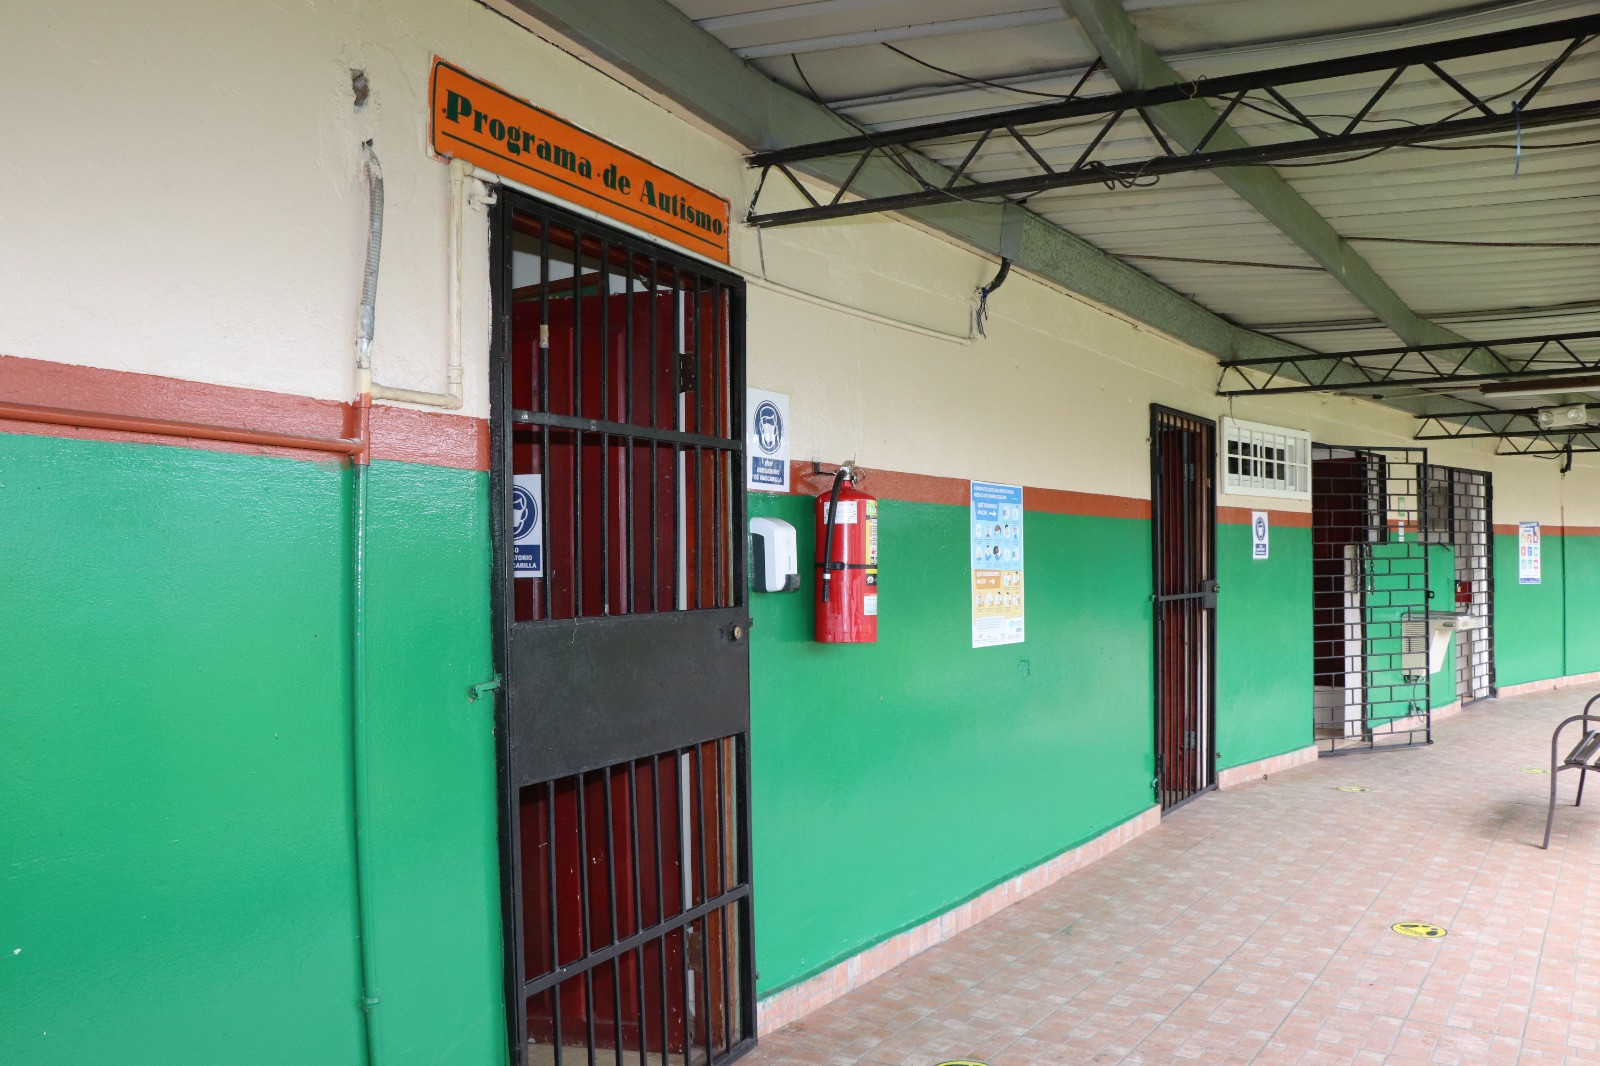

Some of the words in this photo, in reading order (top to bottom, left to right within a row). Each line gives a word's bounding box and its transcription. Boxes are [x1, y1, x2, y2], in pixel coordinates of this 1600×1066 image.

[445, 89, 592, 180] Programa
[602, 163, 631, 195] de
[639, 180, 723, 236] Autismo
